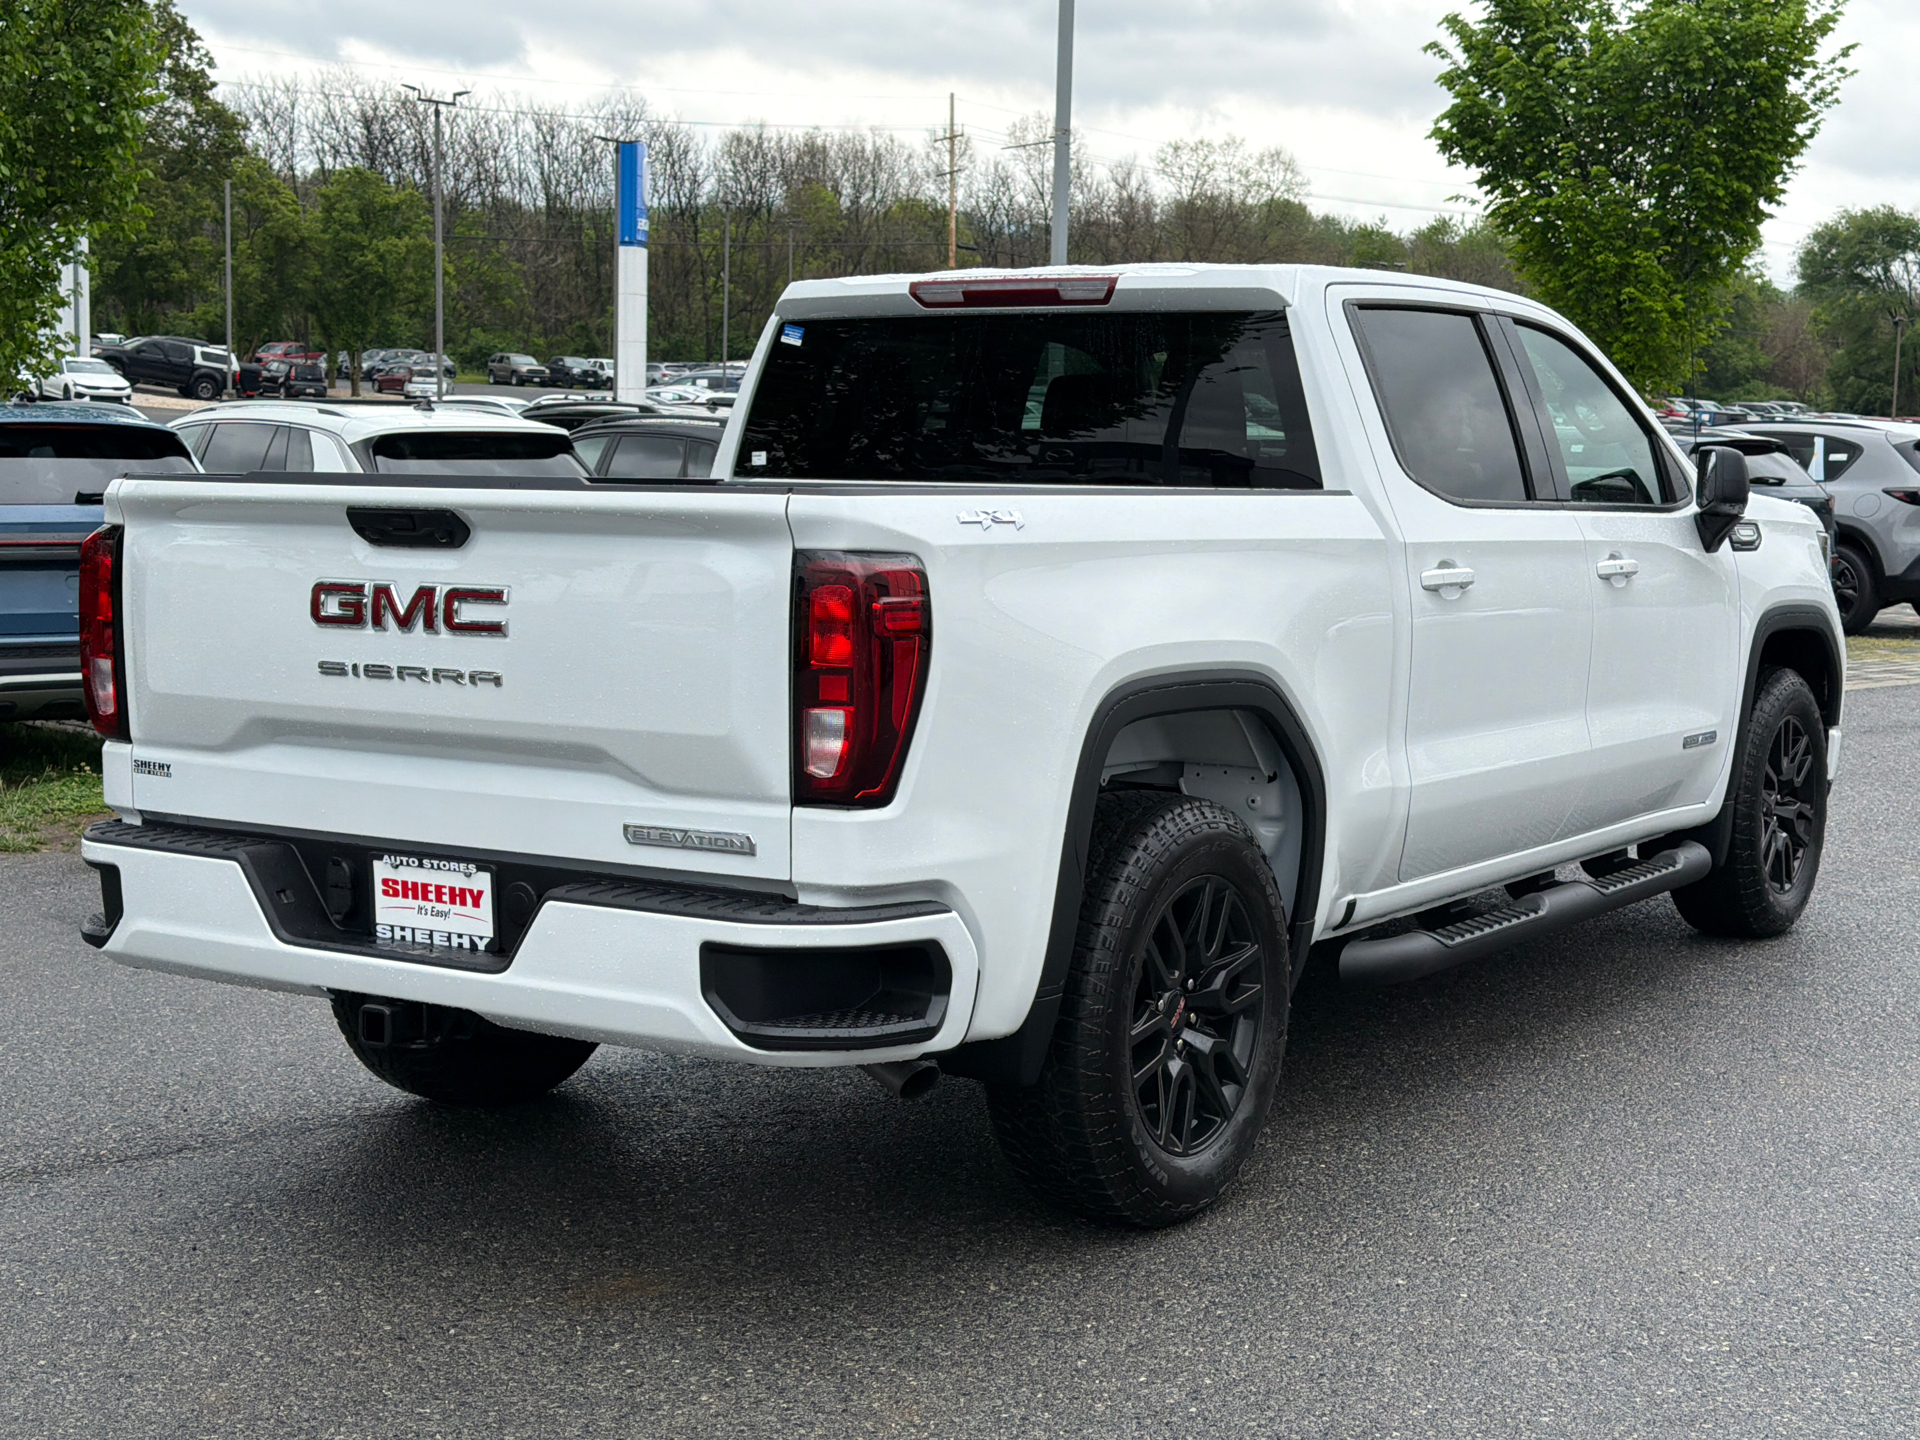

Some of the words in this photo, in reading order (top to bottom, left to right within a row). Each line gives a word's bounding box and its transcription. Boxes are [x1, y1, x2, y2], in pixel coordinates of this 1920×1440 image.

[310, 577, 511, 637] GMC
[317, 660, 504, 688] SIERRA
[133, 759, 171, 772] SHEEHY
[631, 828, 746, 850] ELEVATION
[382, 855, 419, 867] AUTO
[422, 859, 477, 873] STORES
[381, 877, 484, 909] SHEEHY
[416, 904, 429, 917] It's
[430, 906, 451, 921] Easy!
[376, 924, 491, 951] SHEEHY
